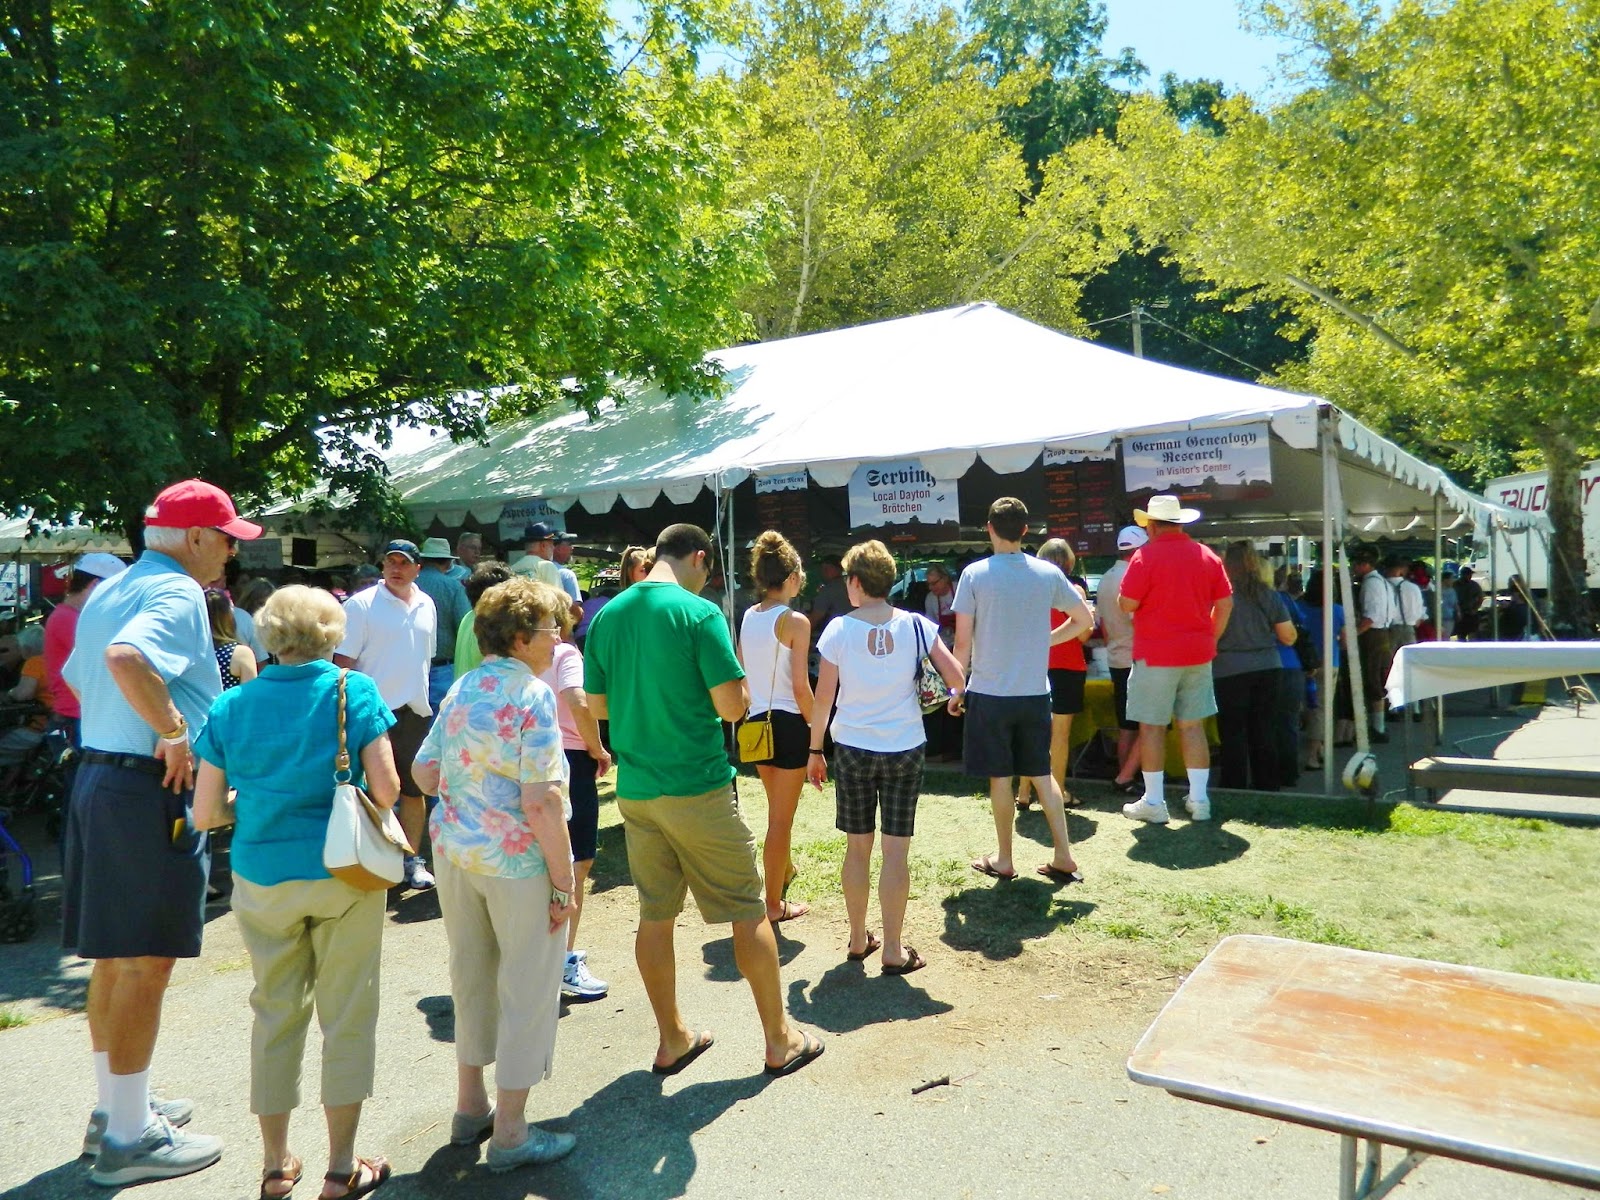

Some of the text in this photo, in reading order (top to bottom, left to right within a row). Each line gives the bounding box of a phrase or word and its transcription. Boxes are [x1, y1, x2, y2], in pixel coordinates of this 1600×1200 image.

[1132, 431, 1257, 453] German Genealogy
[1162, 447, 1223, 463] Research
[866, 466, 937, 487] Serving
[1156, 463, 1232, 477] in Visitor's Center
[873, 490, 931, 502] Local Dayton
[1500, 485, 1549, 511] TRUC
[882, 503, 922, 514] Brötchen
